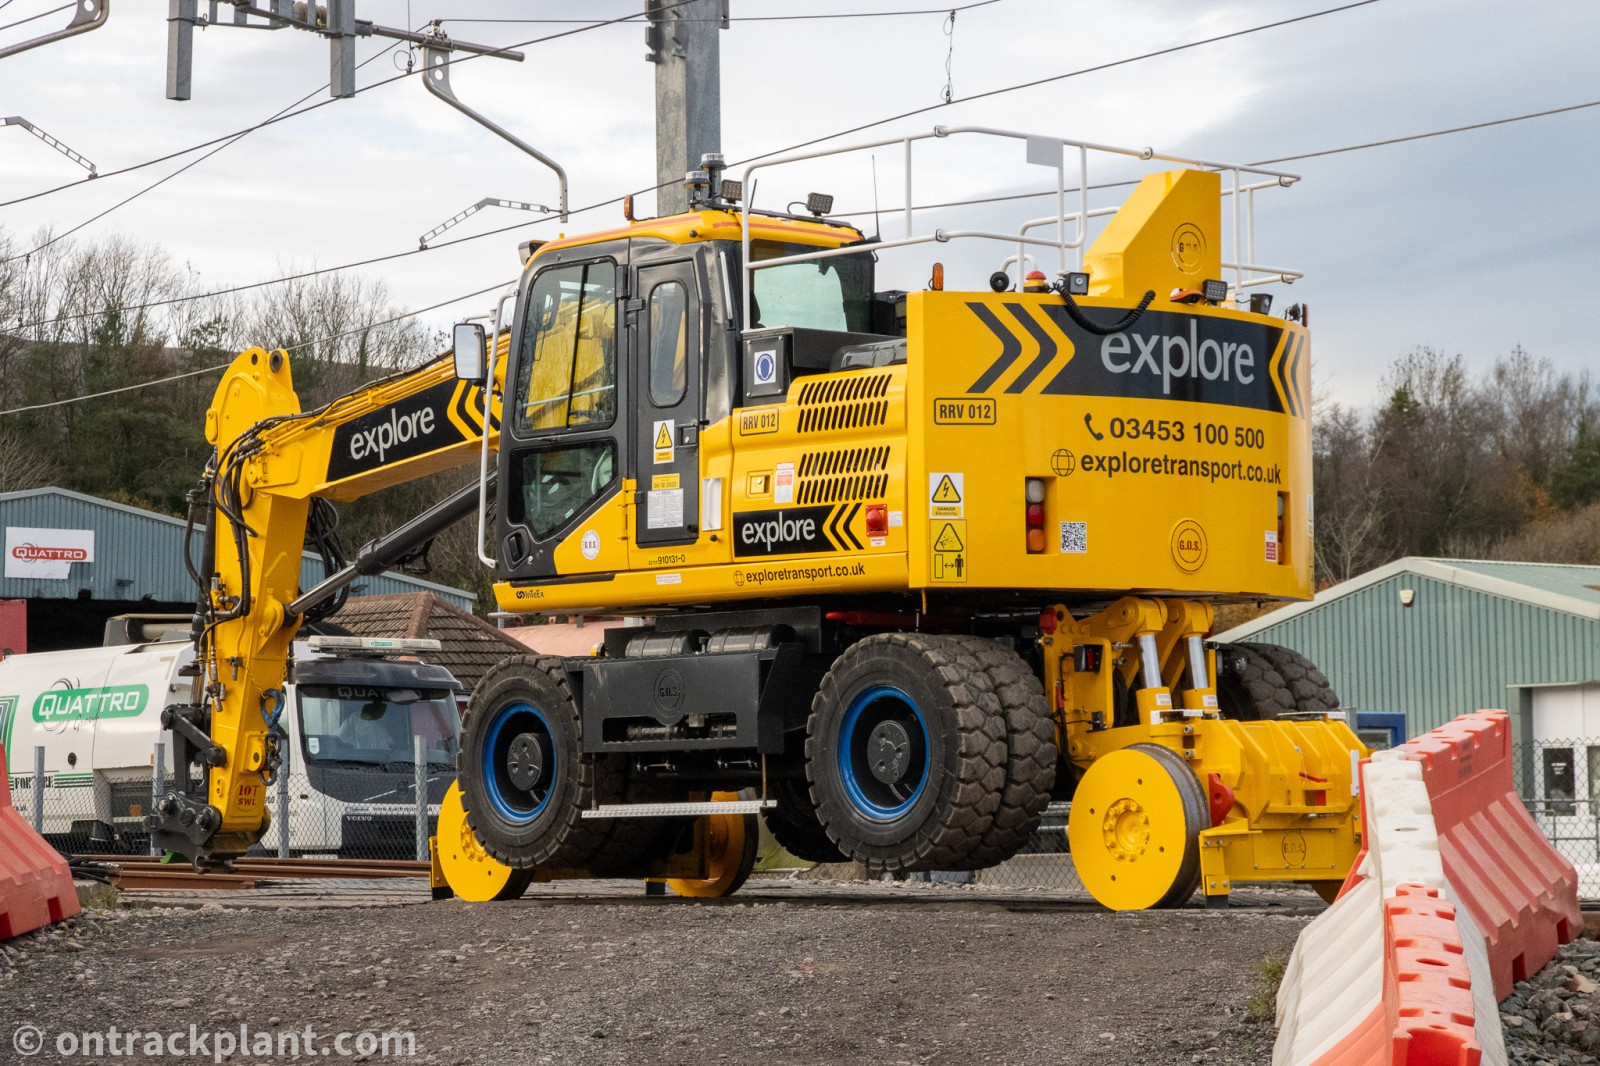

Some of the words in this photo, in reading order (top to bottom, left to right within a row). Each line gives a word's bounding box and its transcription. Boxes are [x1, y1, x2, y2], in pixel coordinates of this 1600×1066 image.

[1100, 318, 1256, 395] explore
[743, 414, 758, 430] RRV
[760, 413, 776, 427] 012
[939, 404, 965, 419] RRV
[967, 404, 991, 420] 012
[350, 406, 435, 463] explore
[1109, 417, 1185, 442] 03453
[1194, 422, 1229, 446] 100
[1234, 426, 1265, 450] 500
[1080, 451, 1282, 485] exploretransport.co.uk
[741, 511, 816, 552] explore
[16, 547, 84, 559] QUATTRO
[1179, 540, 1201, 551] G.O.S.
[657, 554, 686, 565] 910131-0
[746, 563, 866, 585] exploretransport.co.uk
[338, 686, 422, 700] QUAT
[38, 691, 140, 720] QUATTRO
[238, 798, 257, 806] SWL
